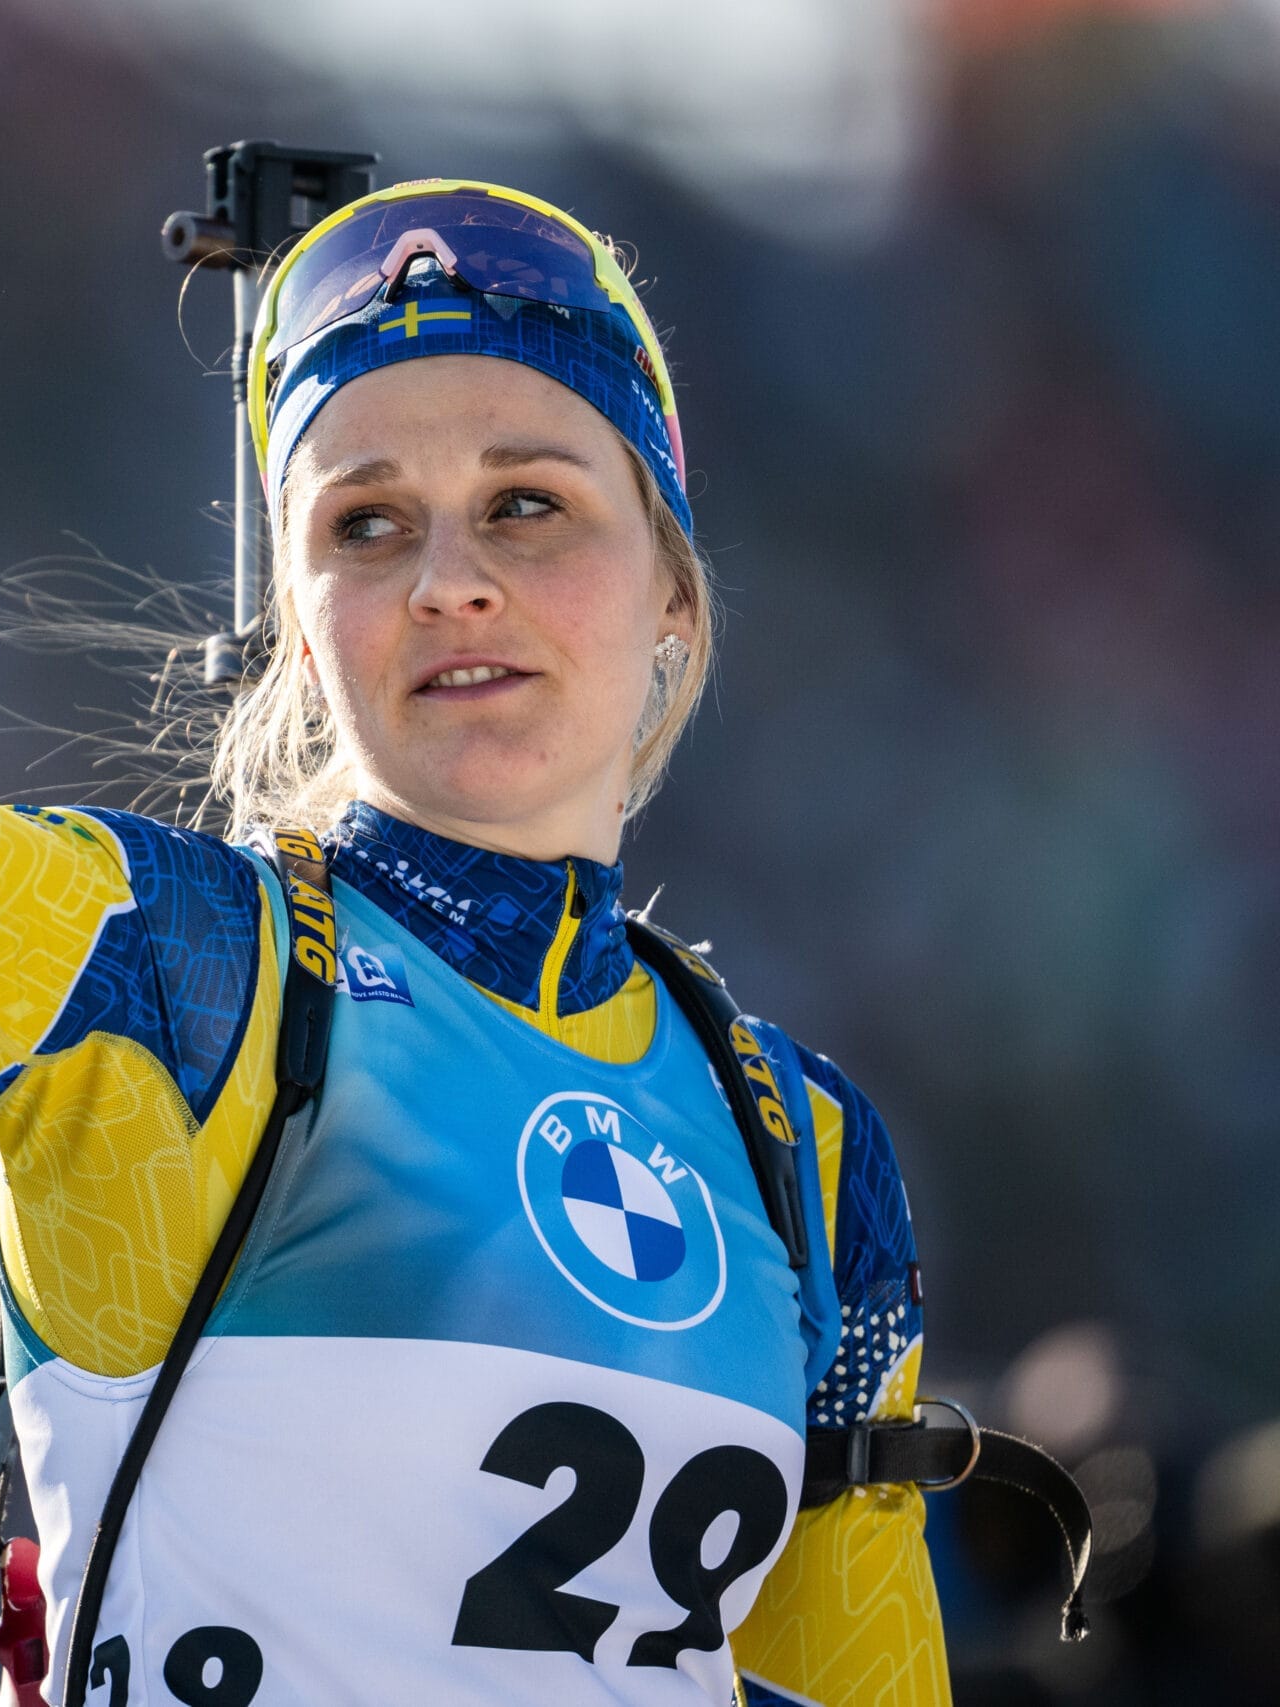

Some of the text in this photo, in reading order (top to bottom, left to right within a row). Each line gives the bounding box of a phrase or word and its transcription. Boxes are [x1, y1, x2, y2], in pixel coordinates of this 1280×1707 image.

[288, 874, 336, 985] ATG
[731, 1023, 796, 1143] ATG
[538, 1105, 689, 1185] BMW
[451, 1401, 788, 1670] 29
